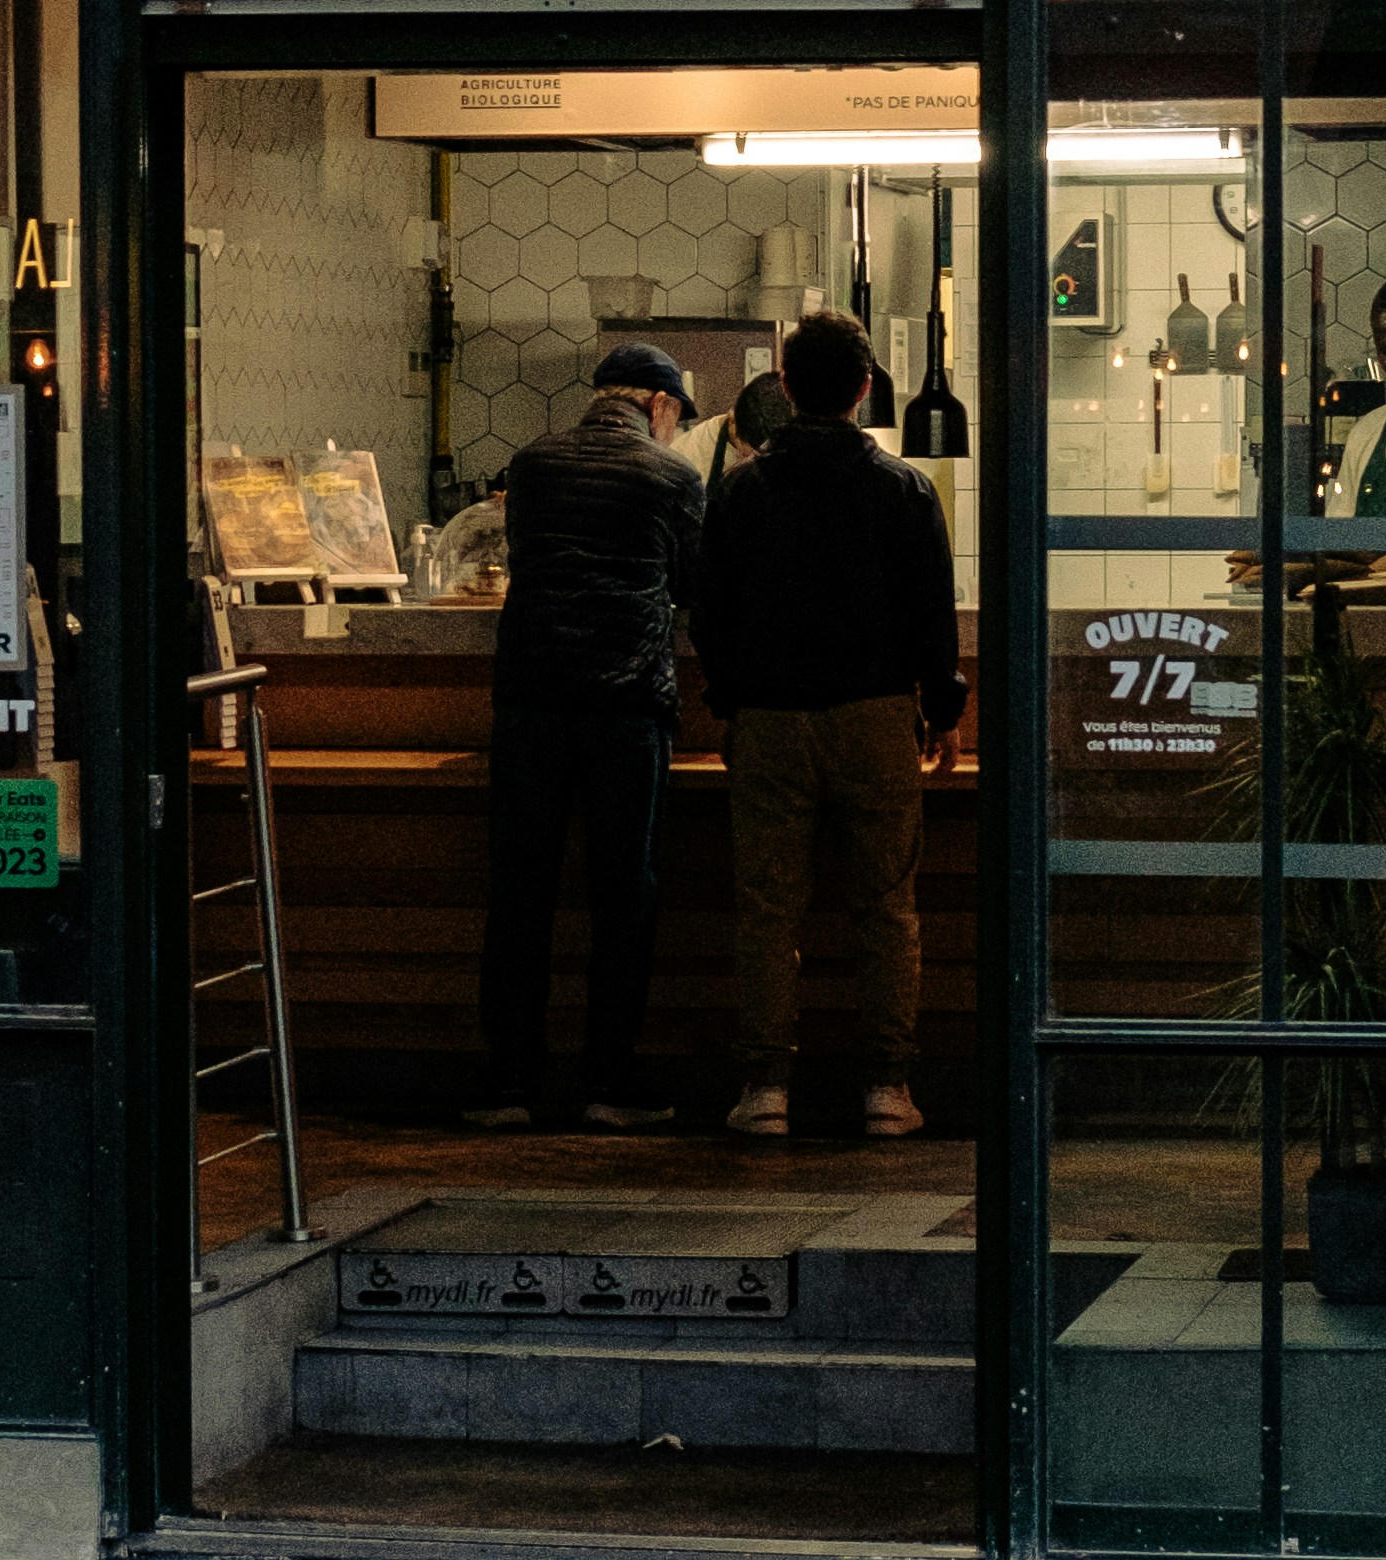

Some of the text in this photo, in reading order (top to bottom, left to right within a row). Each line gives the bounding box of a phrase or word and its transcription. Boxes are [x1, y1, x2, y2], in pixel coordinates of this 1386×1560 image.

[460, 78, 562, 90] AGRICULTURE
[460, 93, 562, 106] BIOLOGIQUE
[888, 95, 911, 109] DE
[1085, 612, 1230, 653] OUVERT
[1109, 653, 1196, 705] 7/7
[1083, 720, 1117, 735] Vous
[1151, 720, 1222, 735] bienvenus
[1086, 739, 1106, 752] de
[7, 792, 46, 806] Eats
[406, 1280, 721, 1312] mydl.fr mydl.fr
